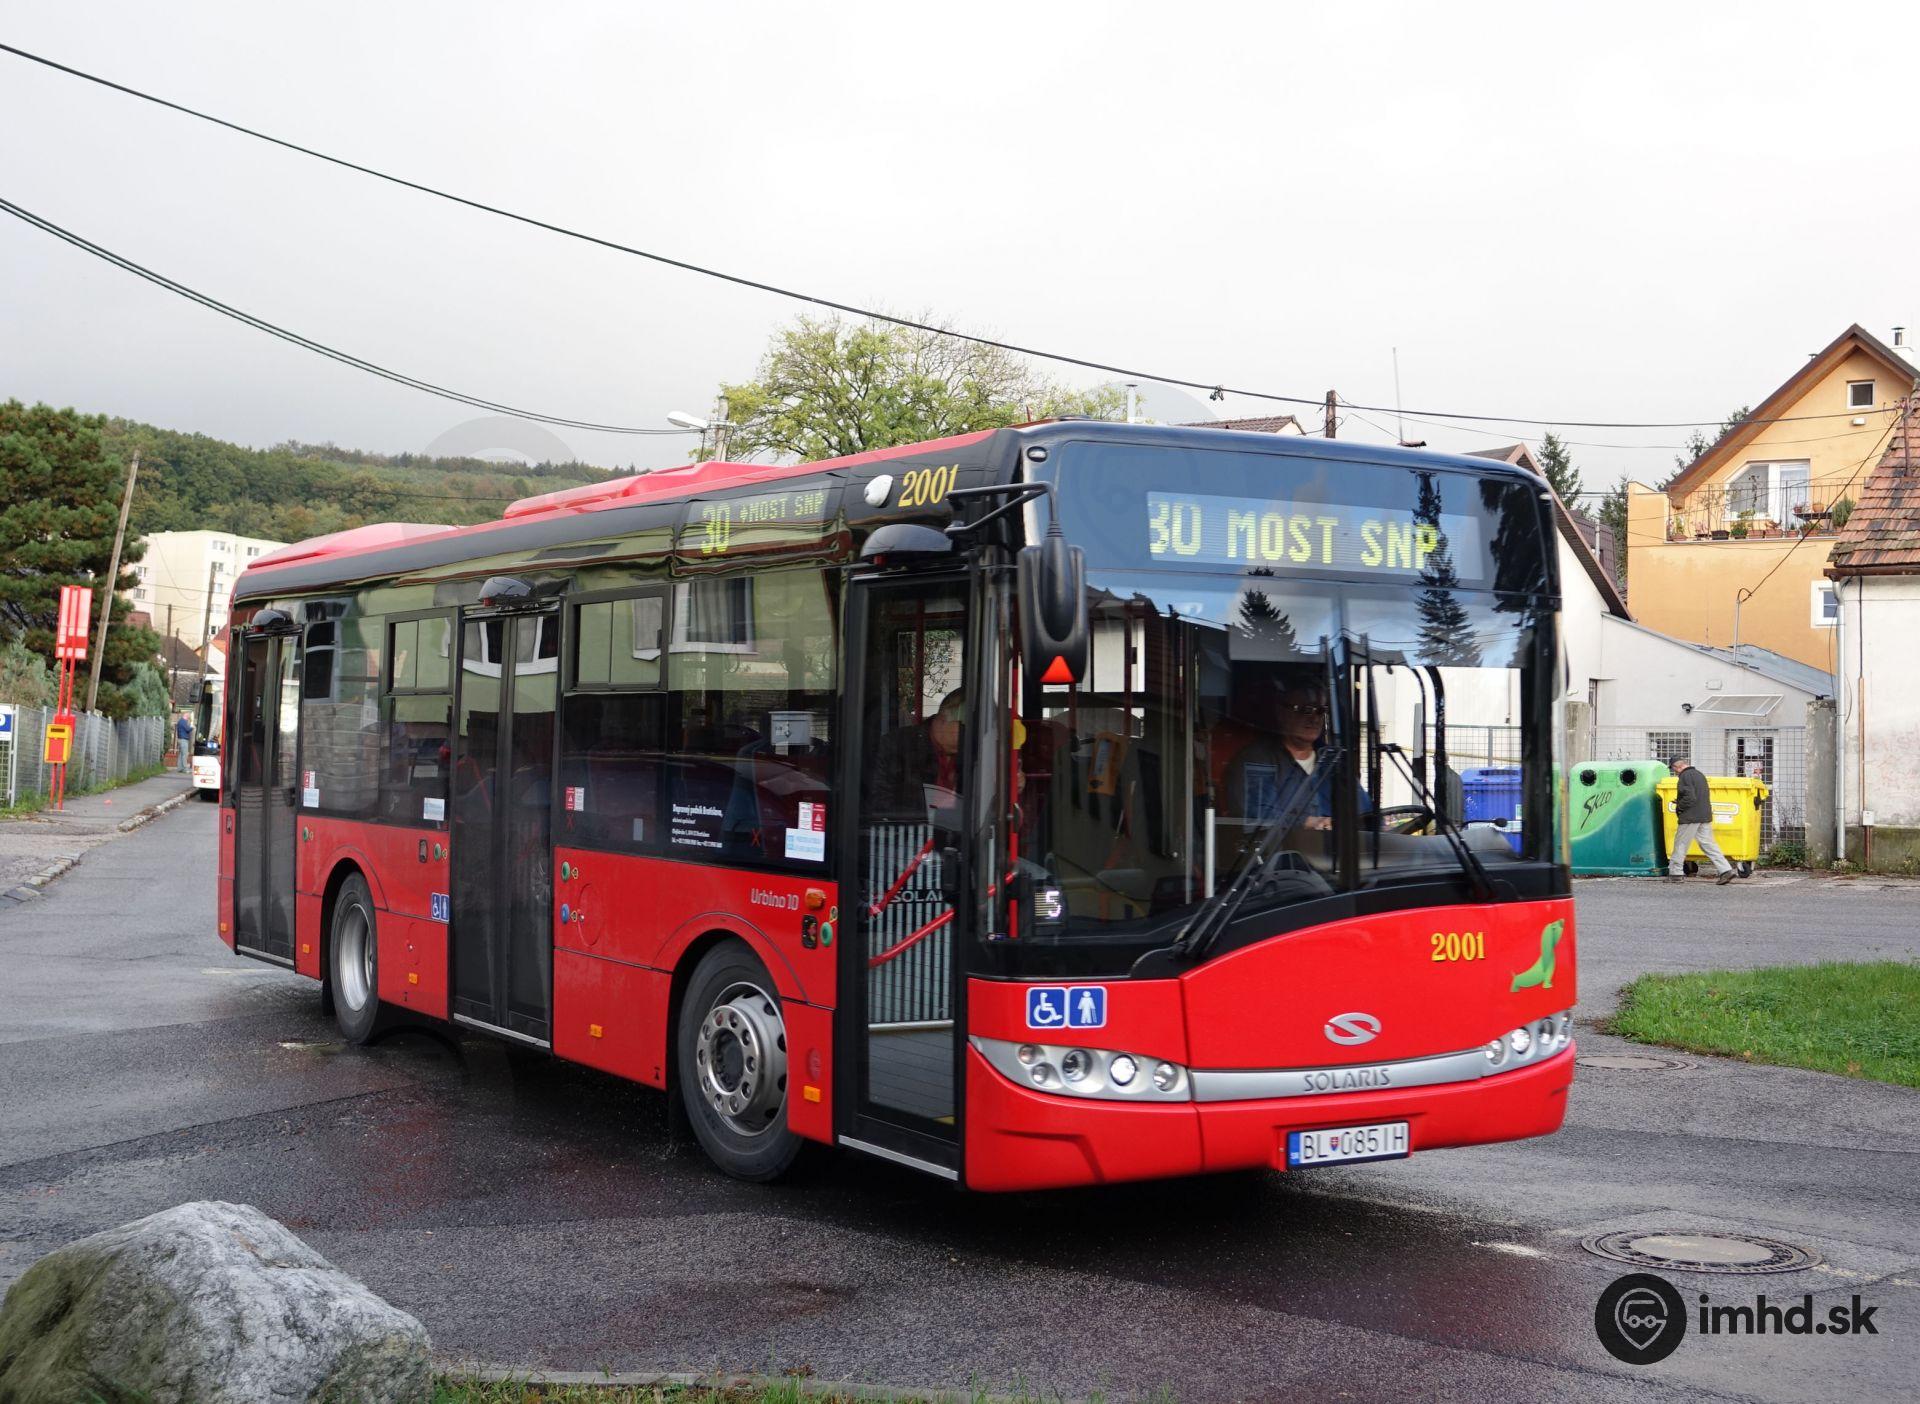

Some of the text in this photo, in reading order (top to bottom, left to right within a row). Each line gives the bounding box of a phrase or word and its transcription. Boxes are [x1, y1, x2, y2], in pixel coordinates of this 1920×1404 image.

[898, 464, 959, 507] 2001
[701, 503, 730, 554] 30
[794, 492, 825, 516] SNP
[1149, 501, 1437, 569] 30 MOST SNP
[751, 887, 799, 911] Urbino 10
[1431, 932, 1485, 961] 2001
[1304, 1068, 1391, 1092] SOLARIS
